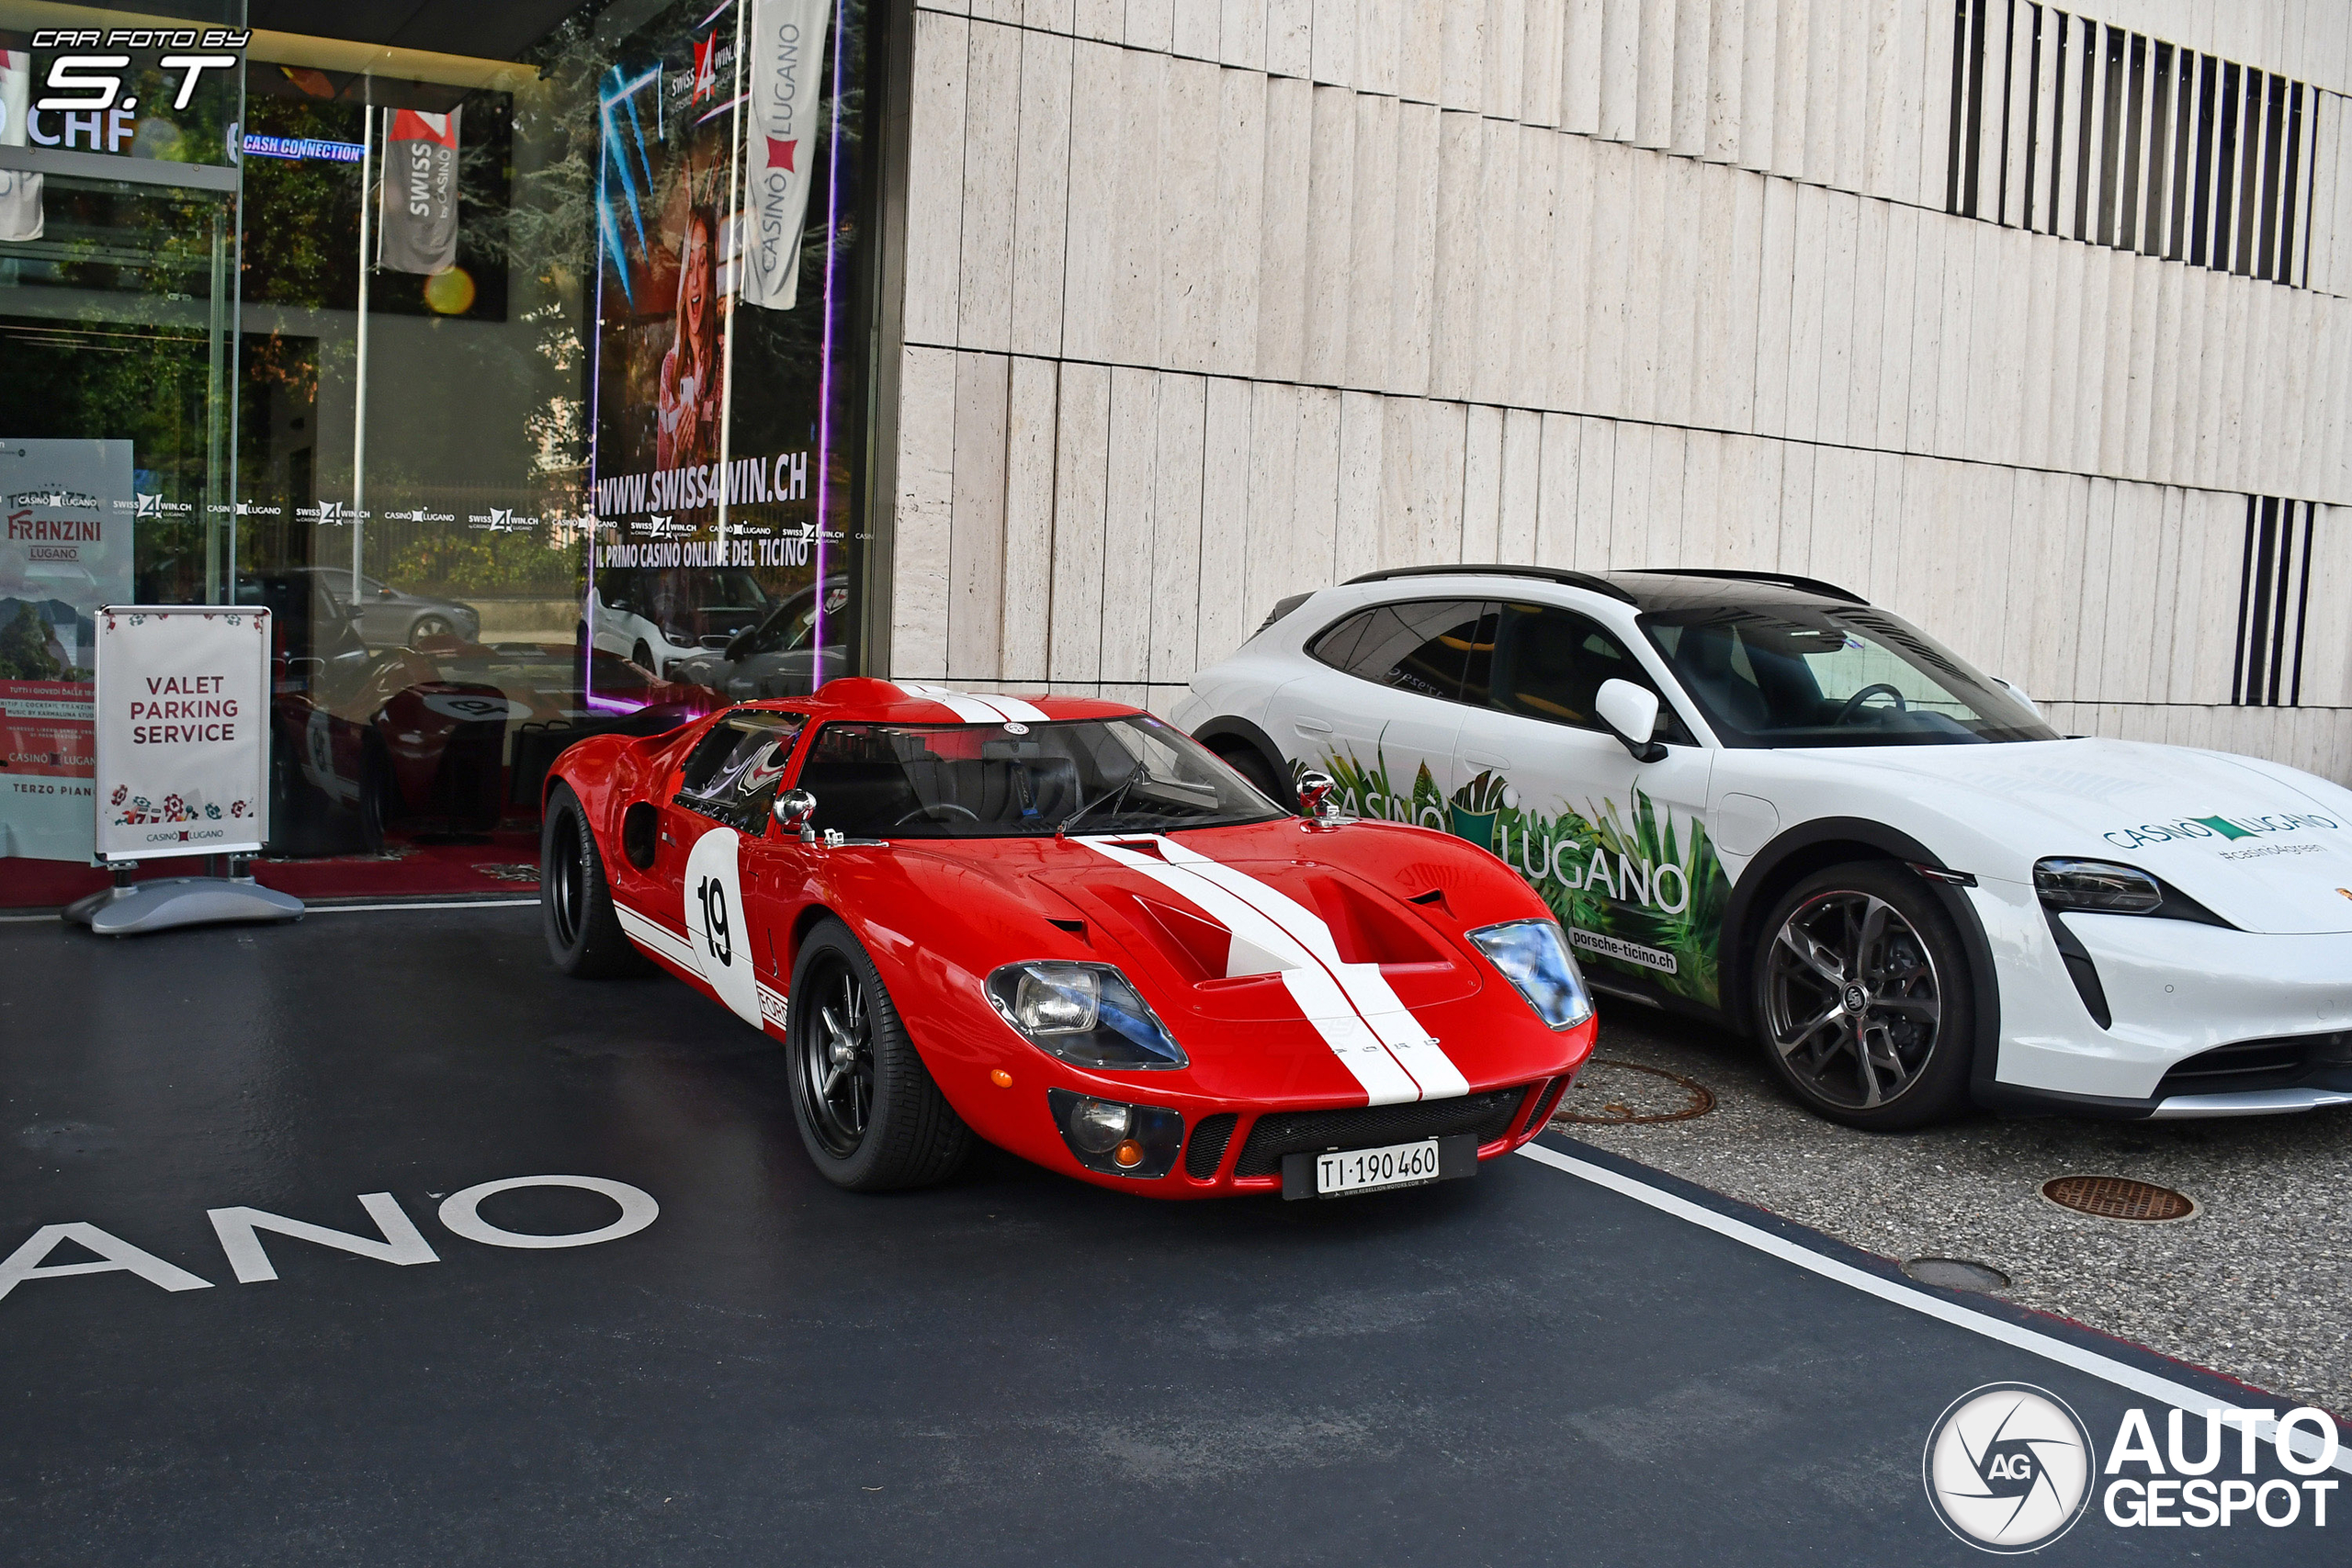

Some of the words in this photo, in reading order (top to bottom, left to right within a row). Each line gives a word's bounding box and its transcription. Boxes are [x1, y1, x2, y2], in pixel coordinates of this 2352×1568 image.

[772, 23, 799, 136] LUGANO
[27, 103, 136, 152] CHF
[243, 135, 279, 152] CASH
[280, 138, 361, 161] CONNECTION
[410, 143, 432, 217] SWISS
[762, 173, 787, 274] CASINÒ
[597, 451, 808, 516] WWW.SWISS4WIN.CH
[62, 498, 97, 507] LUGANO
[247, 506, 281, 515] LUGANO
[7, 510, 101, 541] FRANZINI
[423, 513, 455, 522] LUGANO
[742, 526, 771, 535] LUGANO
[30, 547, 77, 558] LUGANO
[595, 546, 604, 568] IL
[605, 544, 638, 568] PRIMO
[684, 540, 729, 568] ONLINE
[732, 539, 755, 567] DEL
[758, 537, 808, 567] TICINO
[146, 676, 224, 695] VALET
[130, 700, 239, 720] PARKING
[132, 723, 235, 744] SERVICE
[63, 756, 96, 765] LUGAN
[13, 784, 54, 795] TERZO
[61, 786, 95, 796] PIAN
[189, 829, 224, 840] LUGANO
[2103, 818, 2214, 850] CASINÒ
[2229, 813, 2339, 832] LUGANO
[1340, 786, 1445, 831] ASINÒ
[1500, 825, 1689, 915] LUGANO
[696, 874, 732, 968] 19
[1573, 931, 1674, 969] porsche-ticino.ch
